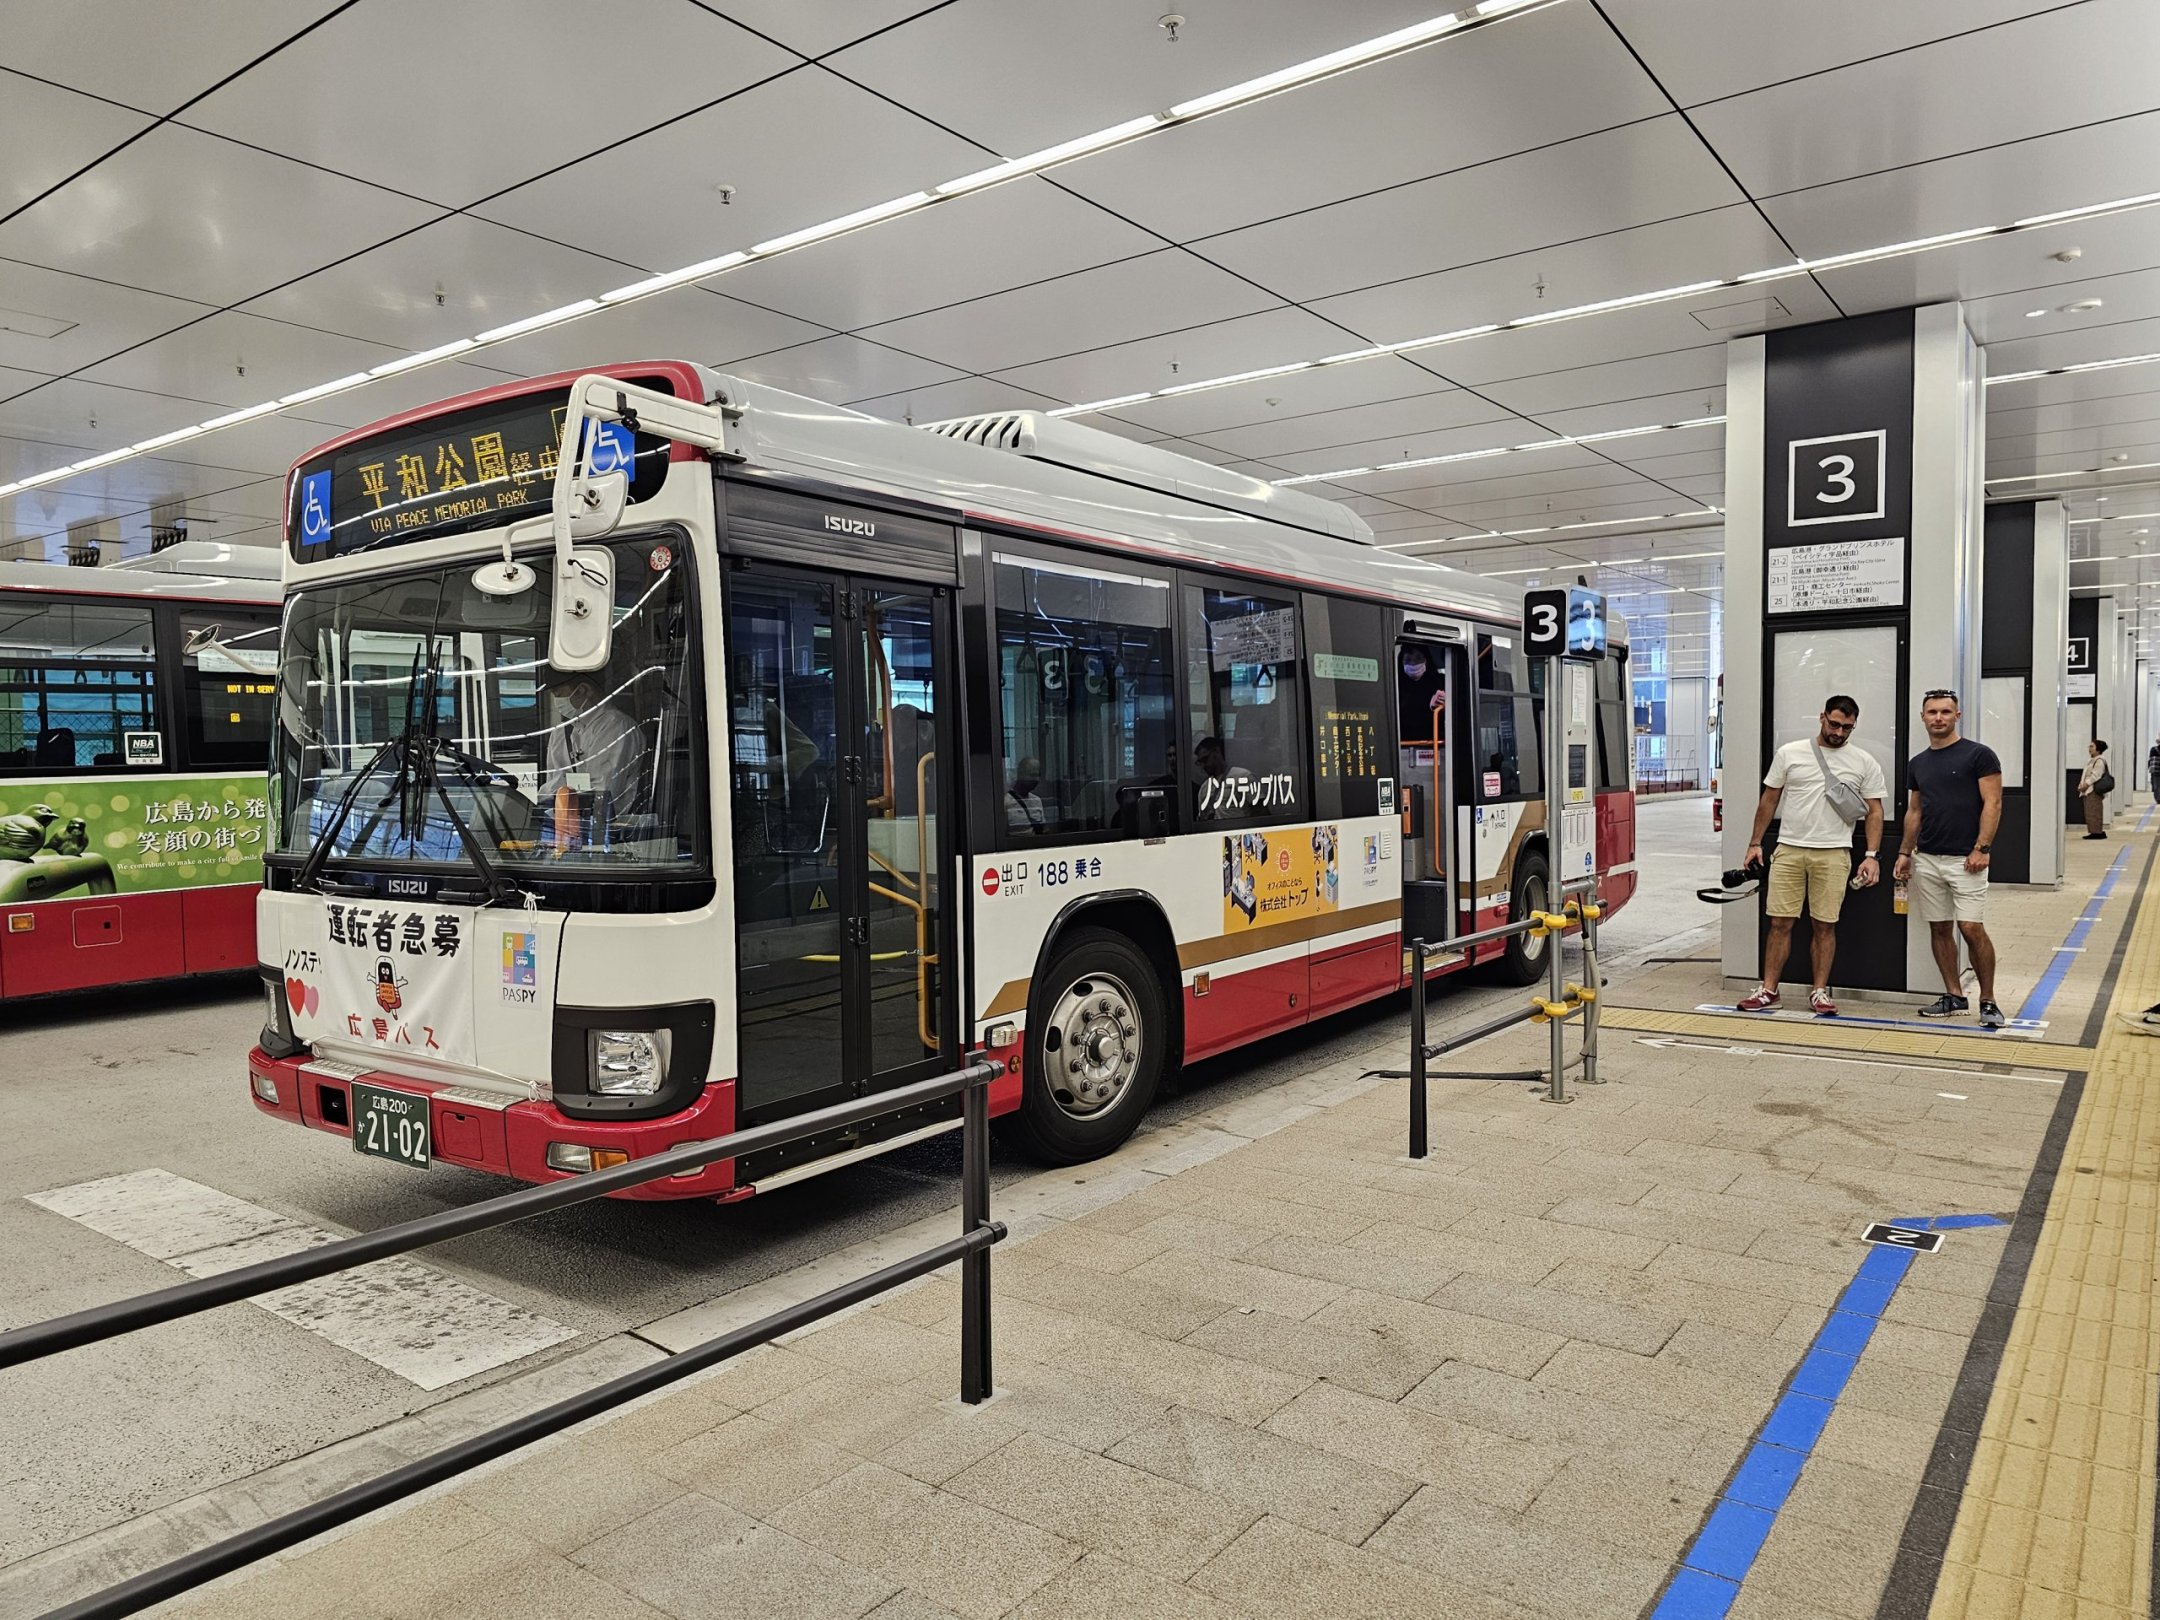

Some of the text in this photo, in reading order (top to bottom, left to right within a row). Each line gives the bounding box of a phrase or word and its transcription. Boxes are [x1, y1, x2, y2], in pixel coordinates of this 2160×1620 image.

[1816, 454, 1856, 504] 3
[371, 488, 528, 534] VIA PEACE MEMORIAL PARK
[824, 514, 875, 537] ISUZU
[657, 555, 663, 563] 6
[1530, 603, 1559, 643] 3
[1580, 600, 1596, 652] 3
[227, 684, 275, 694] NOT IN SERV
[132, 739, 155, 749] NBA
[1200, 773, 1295, 811] ノンステップバス
[145, 797, 267, 825] 広島から発
[136, 825, 262, 855] 笑顔の街づ
[130, 861, 166, 870] contribute
[177, 858, 196, 867] make
[203, 857, 216, 866] city
[218, 855, 230, 864] full
[240, 854, 258, 862] smile
[1001, 862, 1028, 882] 出口
[1038, 857, 1102, 887] 188 乗合
[387, 879, 428, 896] ISUZU
[1004, 884, 1024, 897] EXIT
[1267, 877, 1303, 891] オフィスのことなら
[327, 903, 461, 958] 運転者急募
[503, 987, 536, 1003] PASPY
[348, 1013, 440, 1050] 広島バス
[372, 1095, 408, 1115] 広島200
[366, 1110, 427, 1162] 21-02
[1886, 1229, 1921, 1244] 2
